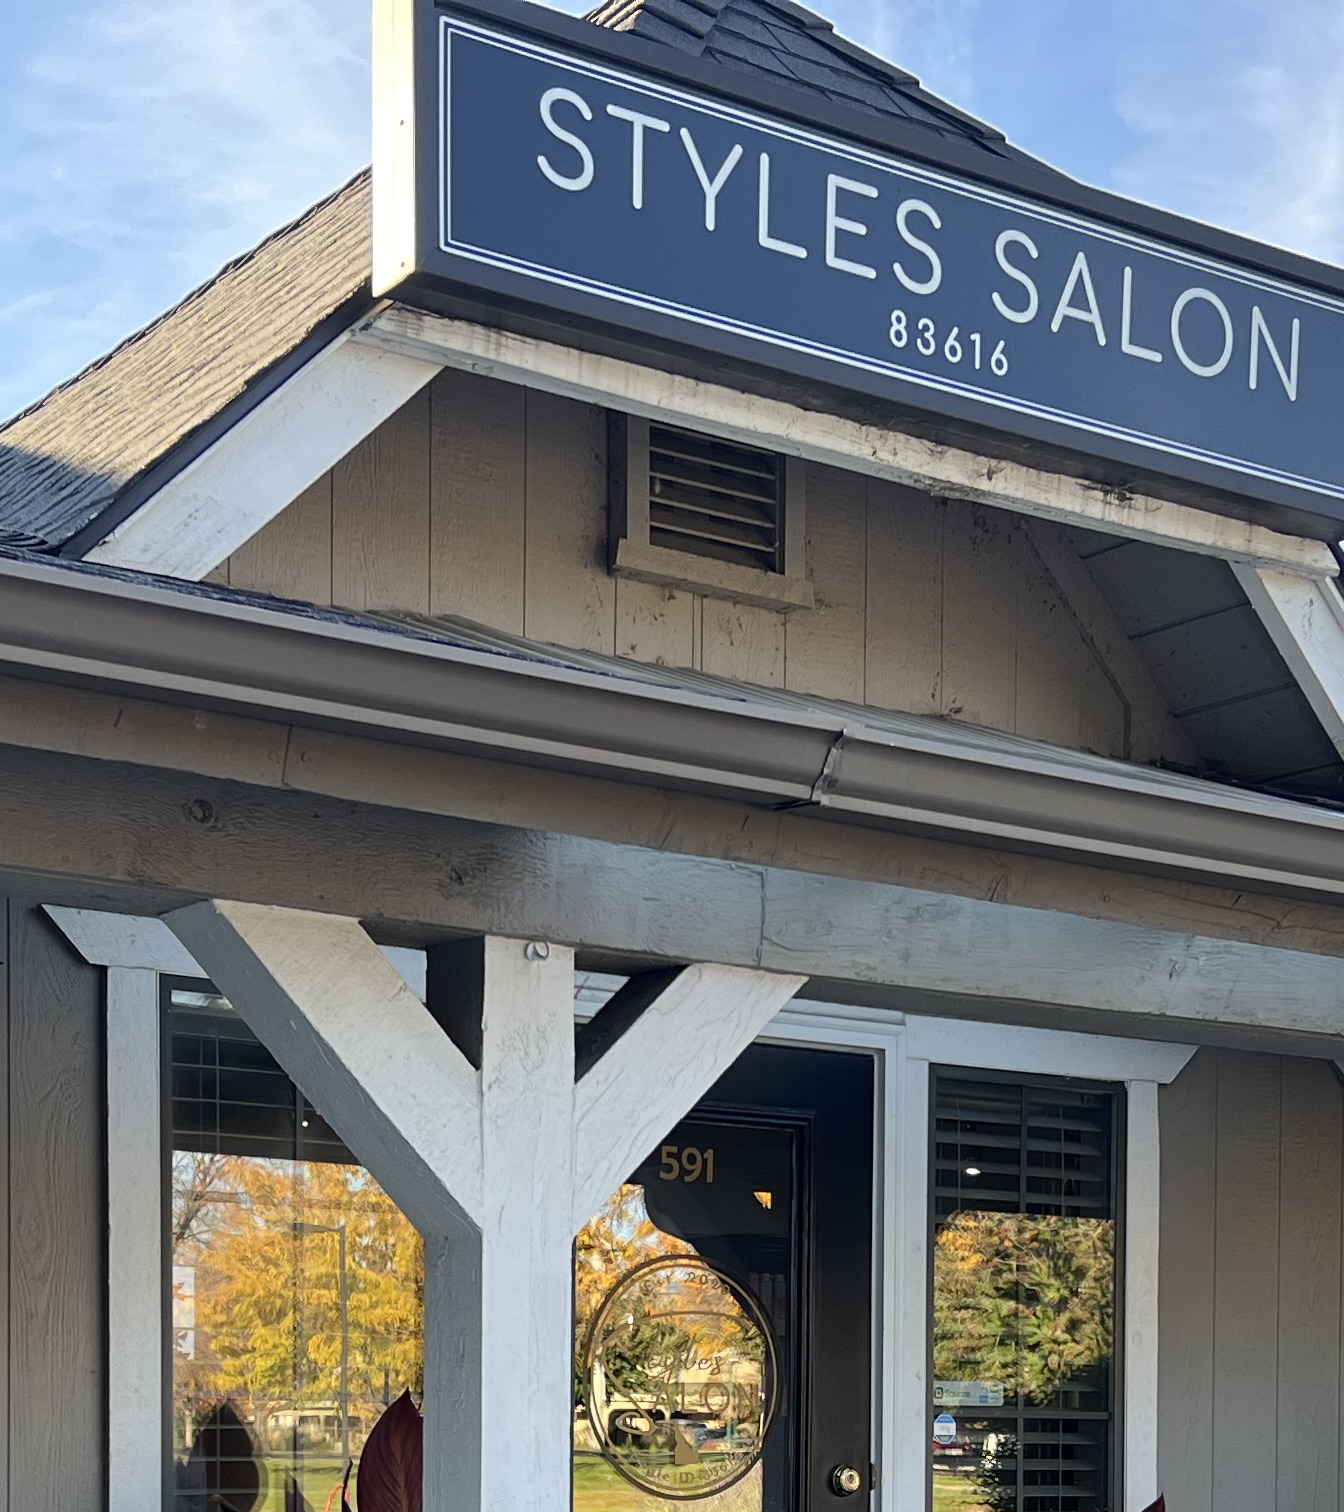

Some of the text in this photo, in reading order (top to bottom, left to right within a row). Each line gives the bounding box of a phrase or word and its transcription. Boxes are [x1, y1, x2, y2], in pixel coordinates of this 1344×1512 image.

[536, 87, 1300, 402] STYLES SALON
[889, 309, 1009, 377] 83616
[659, 1145, 714, 1183] 591
